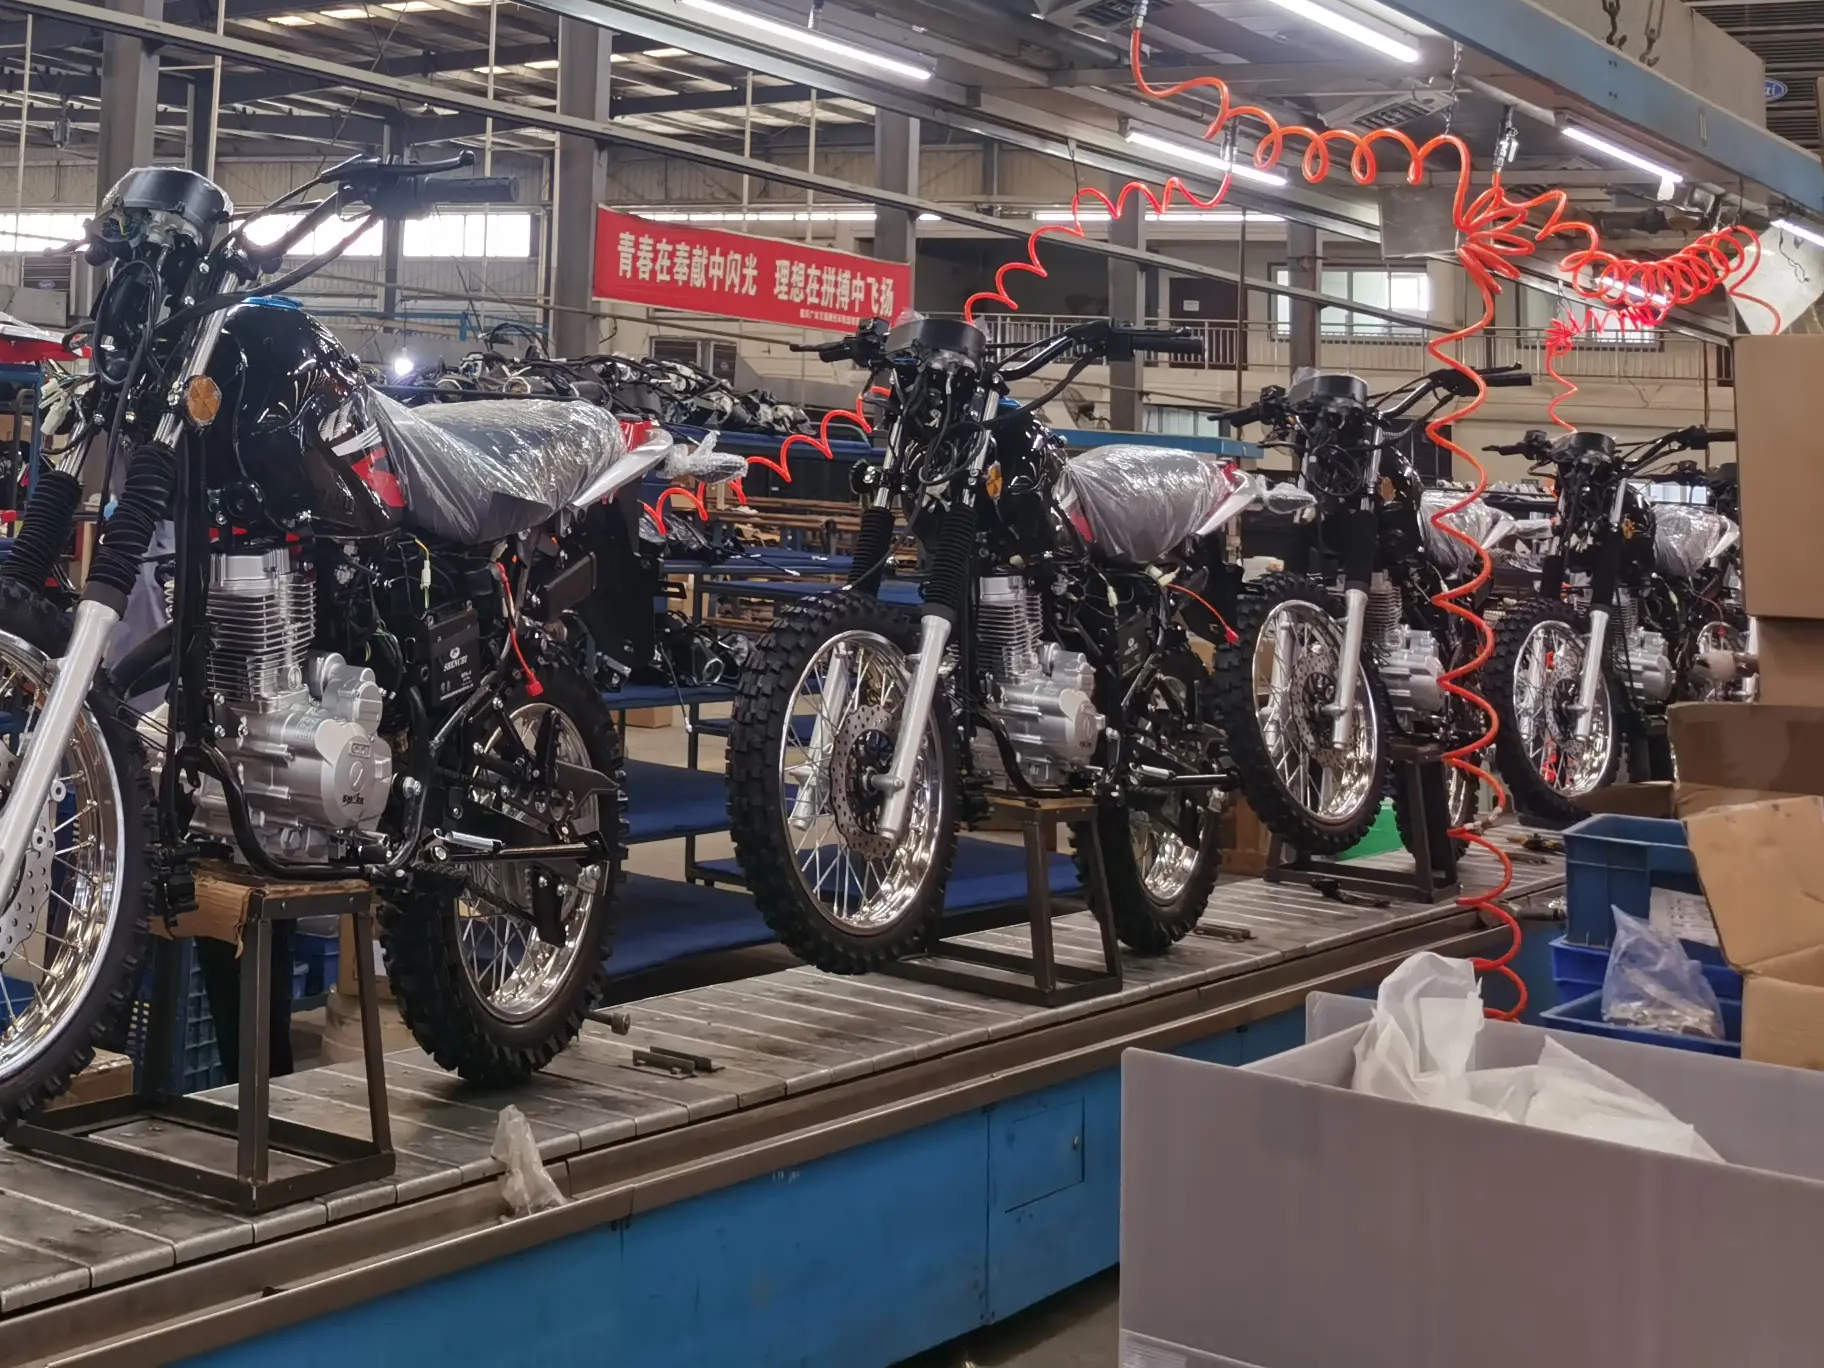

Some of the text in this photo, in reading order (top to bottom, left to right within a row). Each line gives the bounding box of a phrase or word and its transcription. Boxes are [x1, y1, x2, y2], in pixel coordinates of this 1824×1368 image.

[617, 232, 894, 317] 青春在奉献中闪光 理想在拼搏中飞扬
